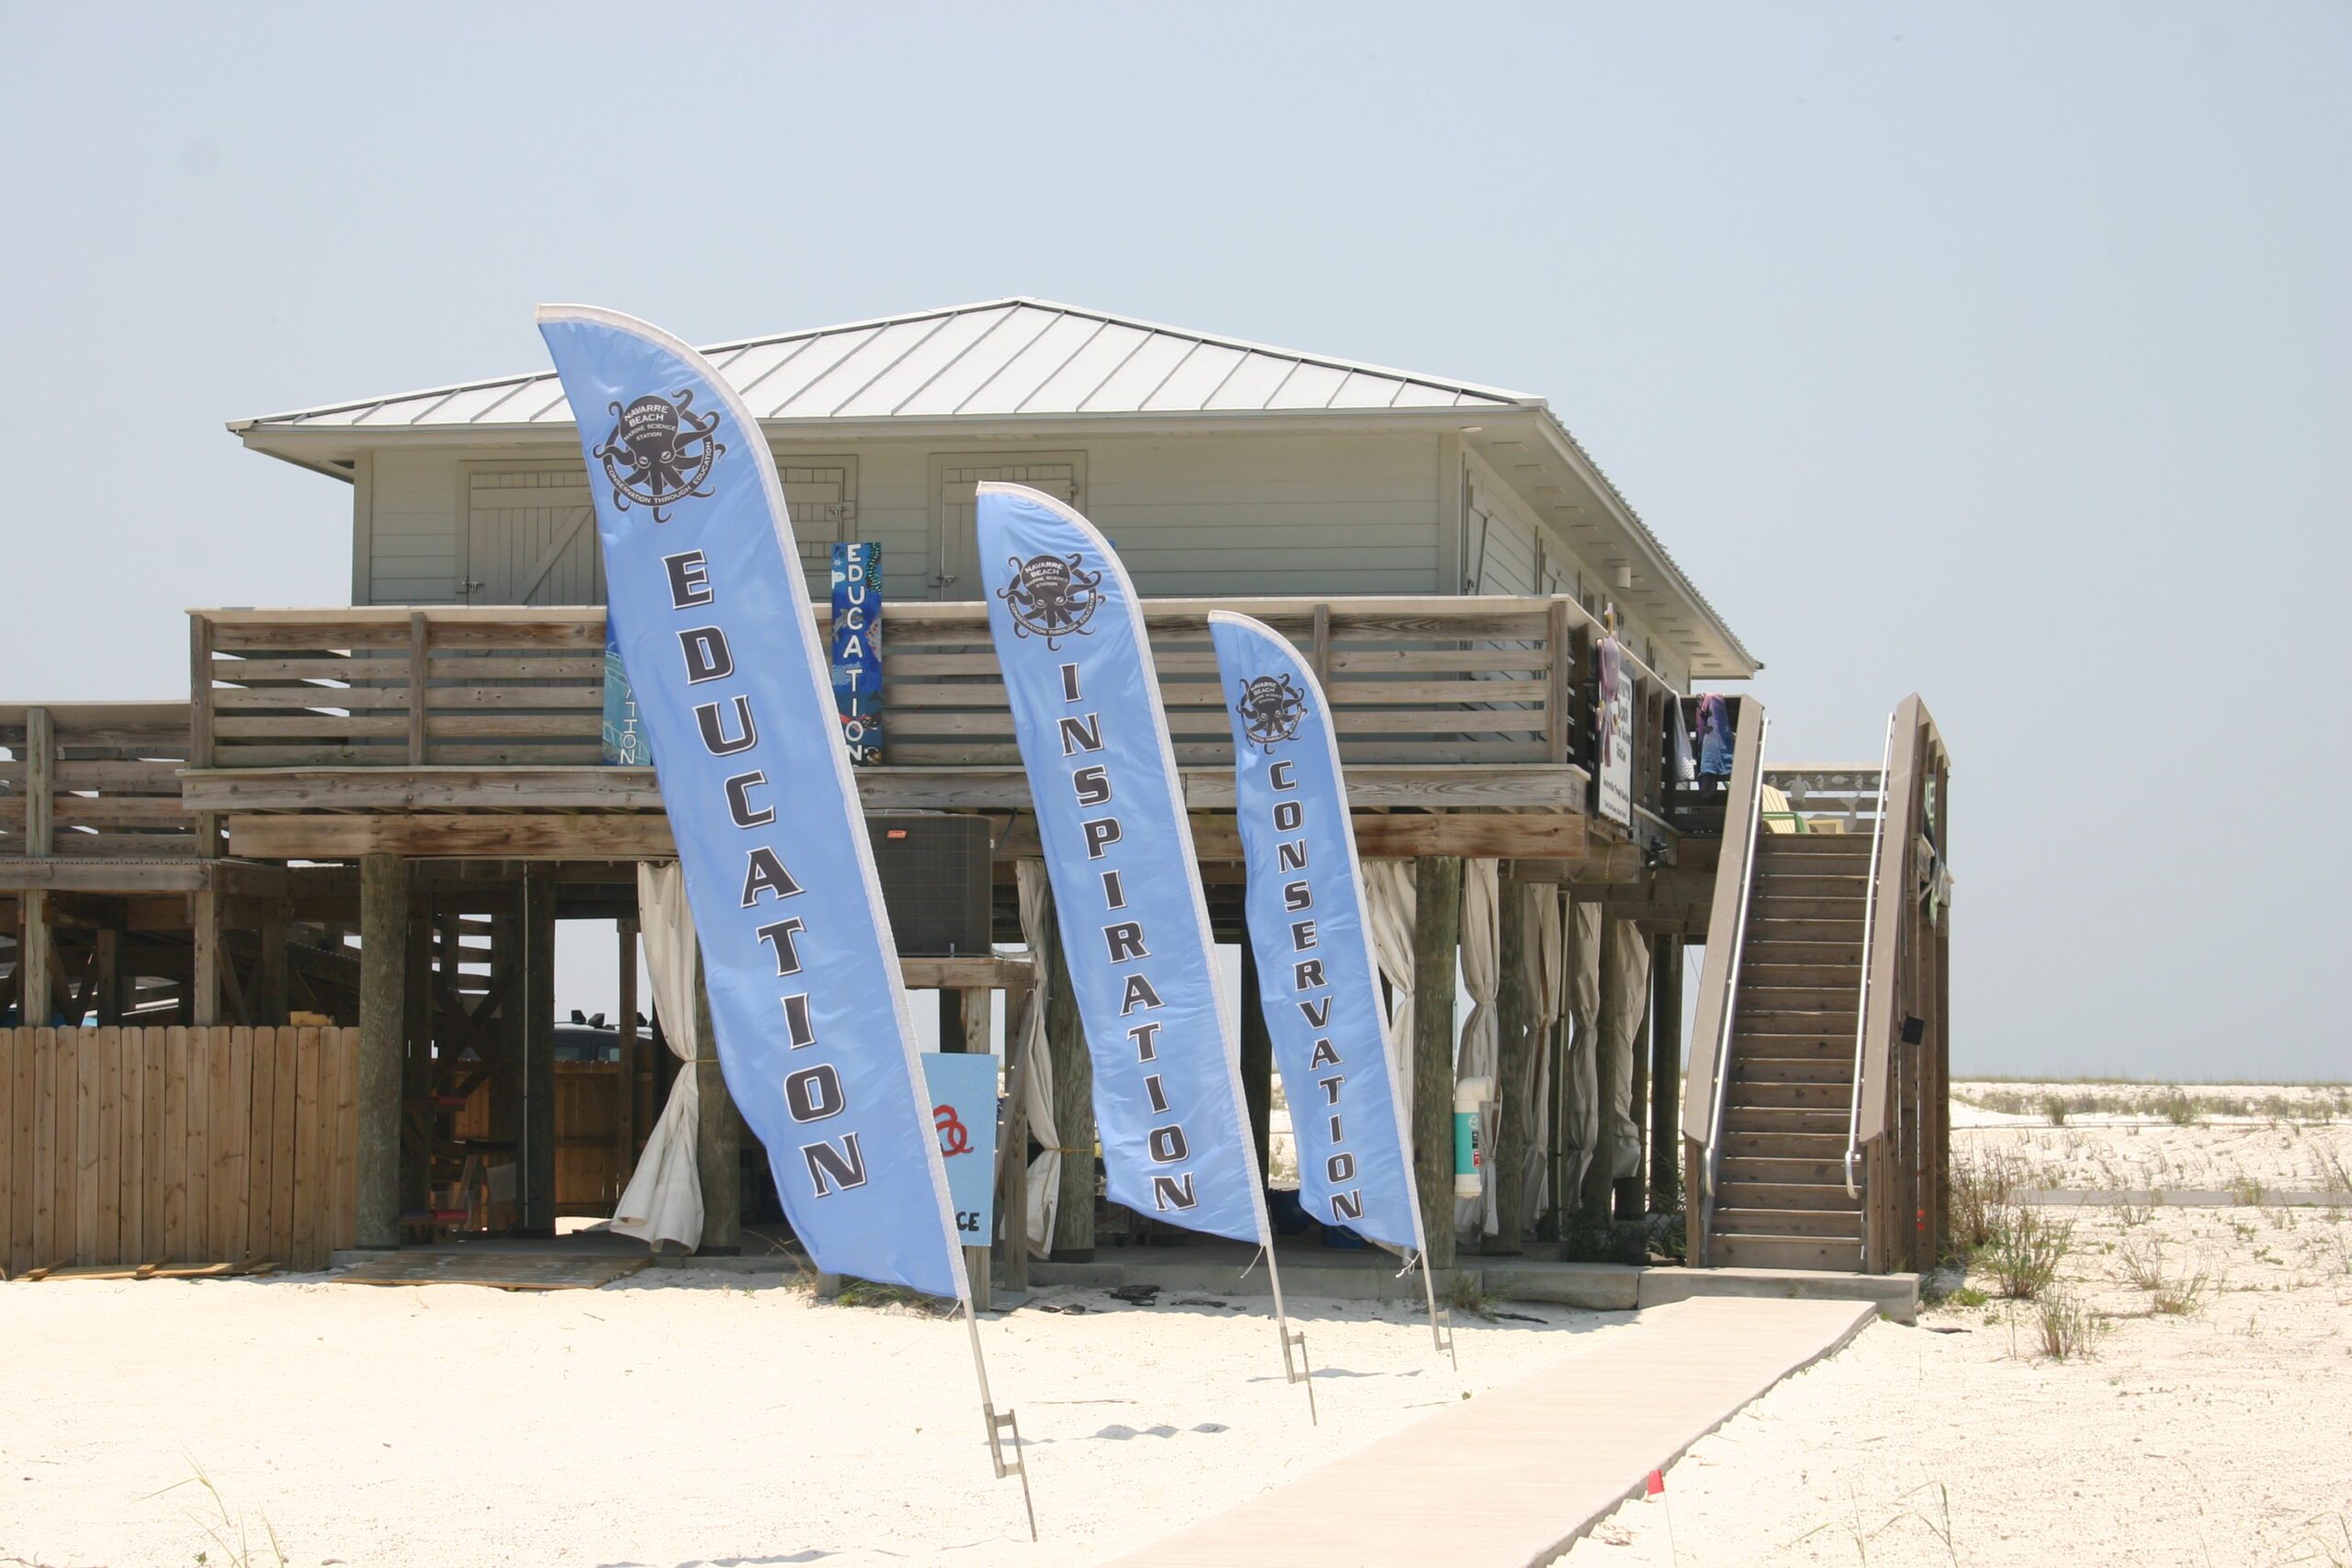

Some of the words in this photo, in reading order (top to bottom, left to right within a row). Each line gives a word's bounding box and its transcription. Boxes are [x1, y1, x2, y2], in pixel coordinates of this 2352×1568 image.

[625, 404, 669, 422] NAVARRE
[628, 413, 664, 427] BEACH
[624, 425, 645, 441] MARINE
[647, 423, 676, 432] SCIENCE
[636, 432, 662, 441] STATION
[606, 464, 650, 503] CONSERVATION
[653, 486, 692, 503] THROUGH
[693, 442, 712, 485] EDUCATION
[1024, 561, 1064, 573] NAVARRE
[1030, 569, 1059, 578] BEACH
[842, 543, 865, 761] EDUCATION
[661, 549, 868, 1198] EDUCATION
[1058, 661, 1199, 1212] INSPIRATION
[1269, 759, 1365, 1223] CONSERVATION
